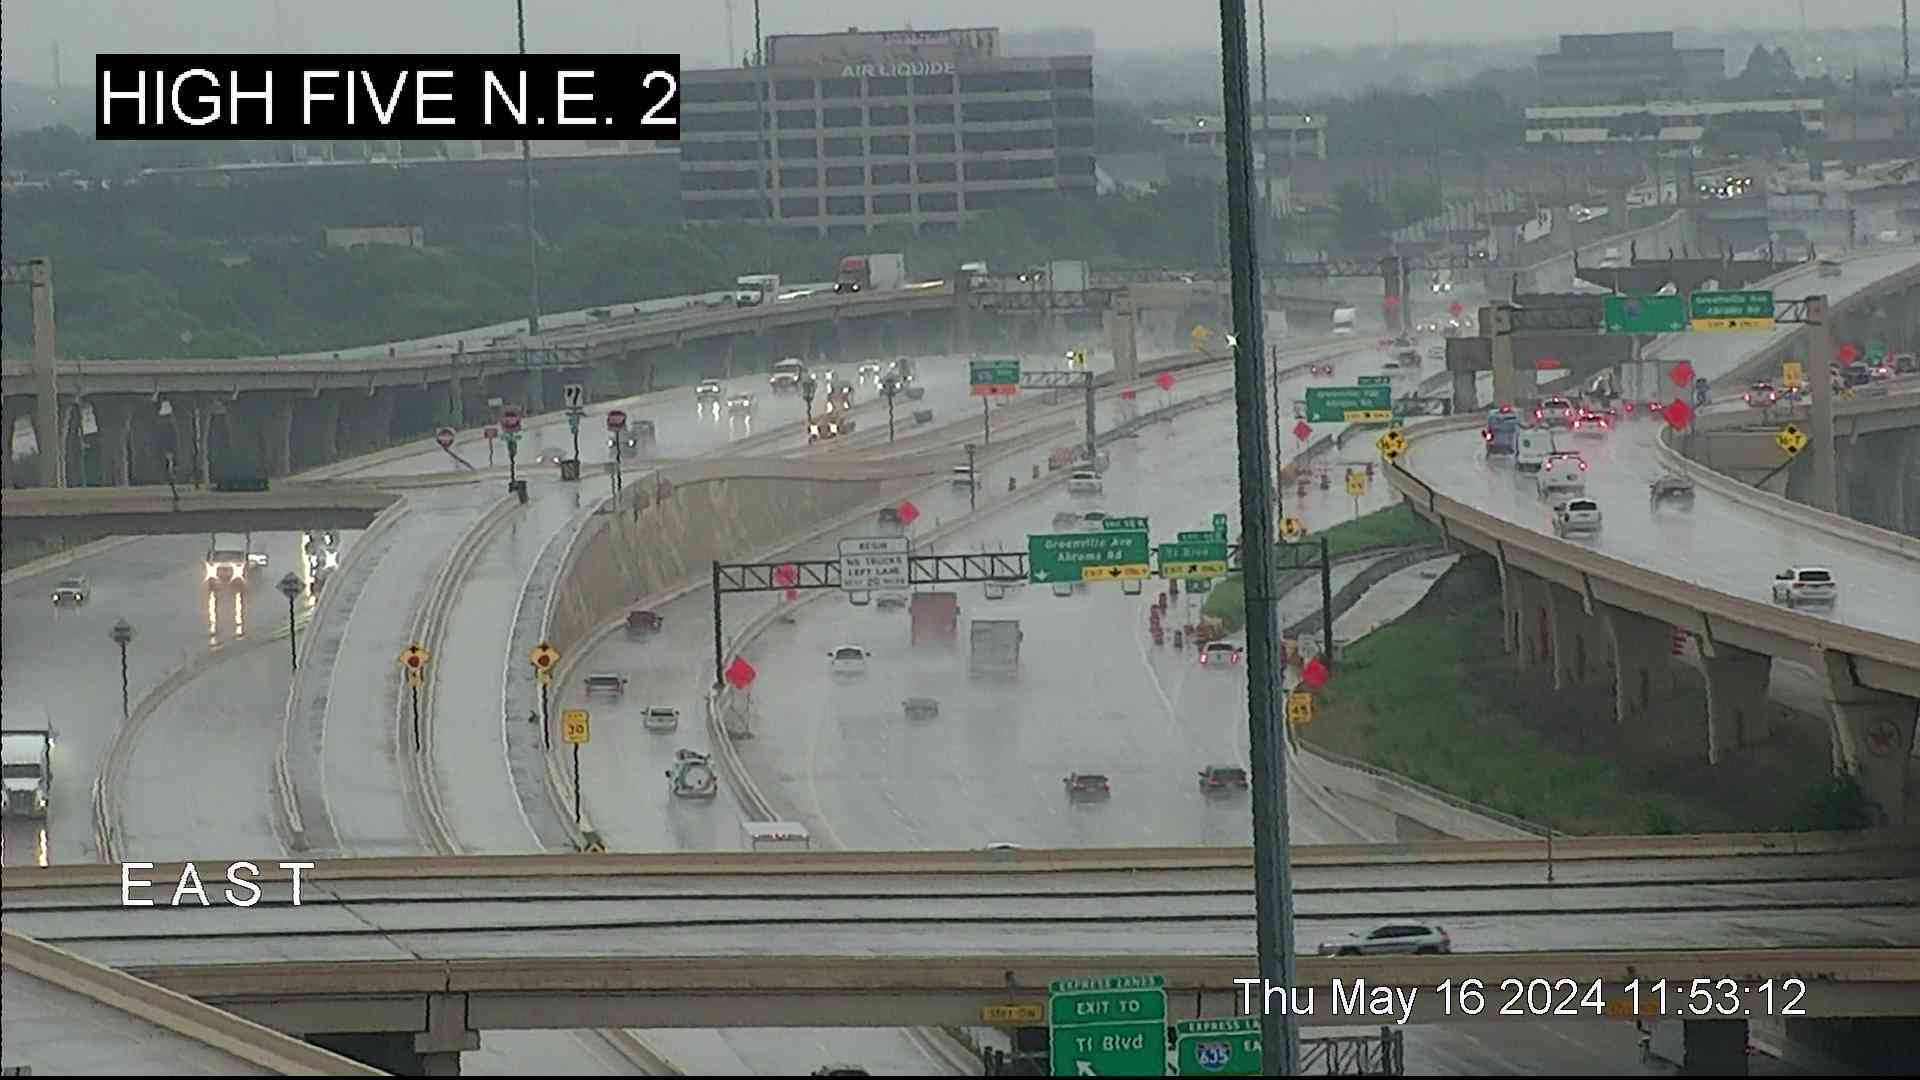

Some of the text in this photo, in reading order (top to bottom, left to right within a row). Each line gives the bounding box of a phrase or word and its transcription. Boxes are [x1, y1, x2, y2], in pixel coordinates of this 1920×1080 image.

[841, 62, 957, 78] AIR LIQUIDE
[1044, 537, 1132, 550] Greenville Ave
[865, 556, 902, 565] TRUCKS
[1057, 550, 1122, 561] Abrams Rd
[848, 567, 899, 577] LEFT LANE
[1059, 976, 1155, 993] EXPRESS LANES
[1076, 999, 1141, 1016] EXIT TO
[1188, 1020, 1240, 1032] EXPRESS
[1075, 1033, 1144, 1053] TI Blvd
[1243, 1039, 1262, 1052] EA
[1200, 1049, 1229, 1065] 635
